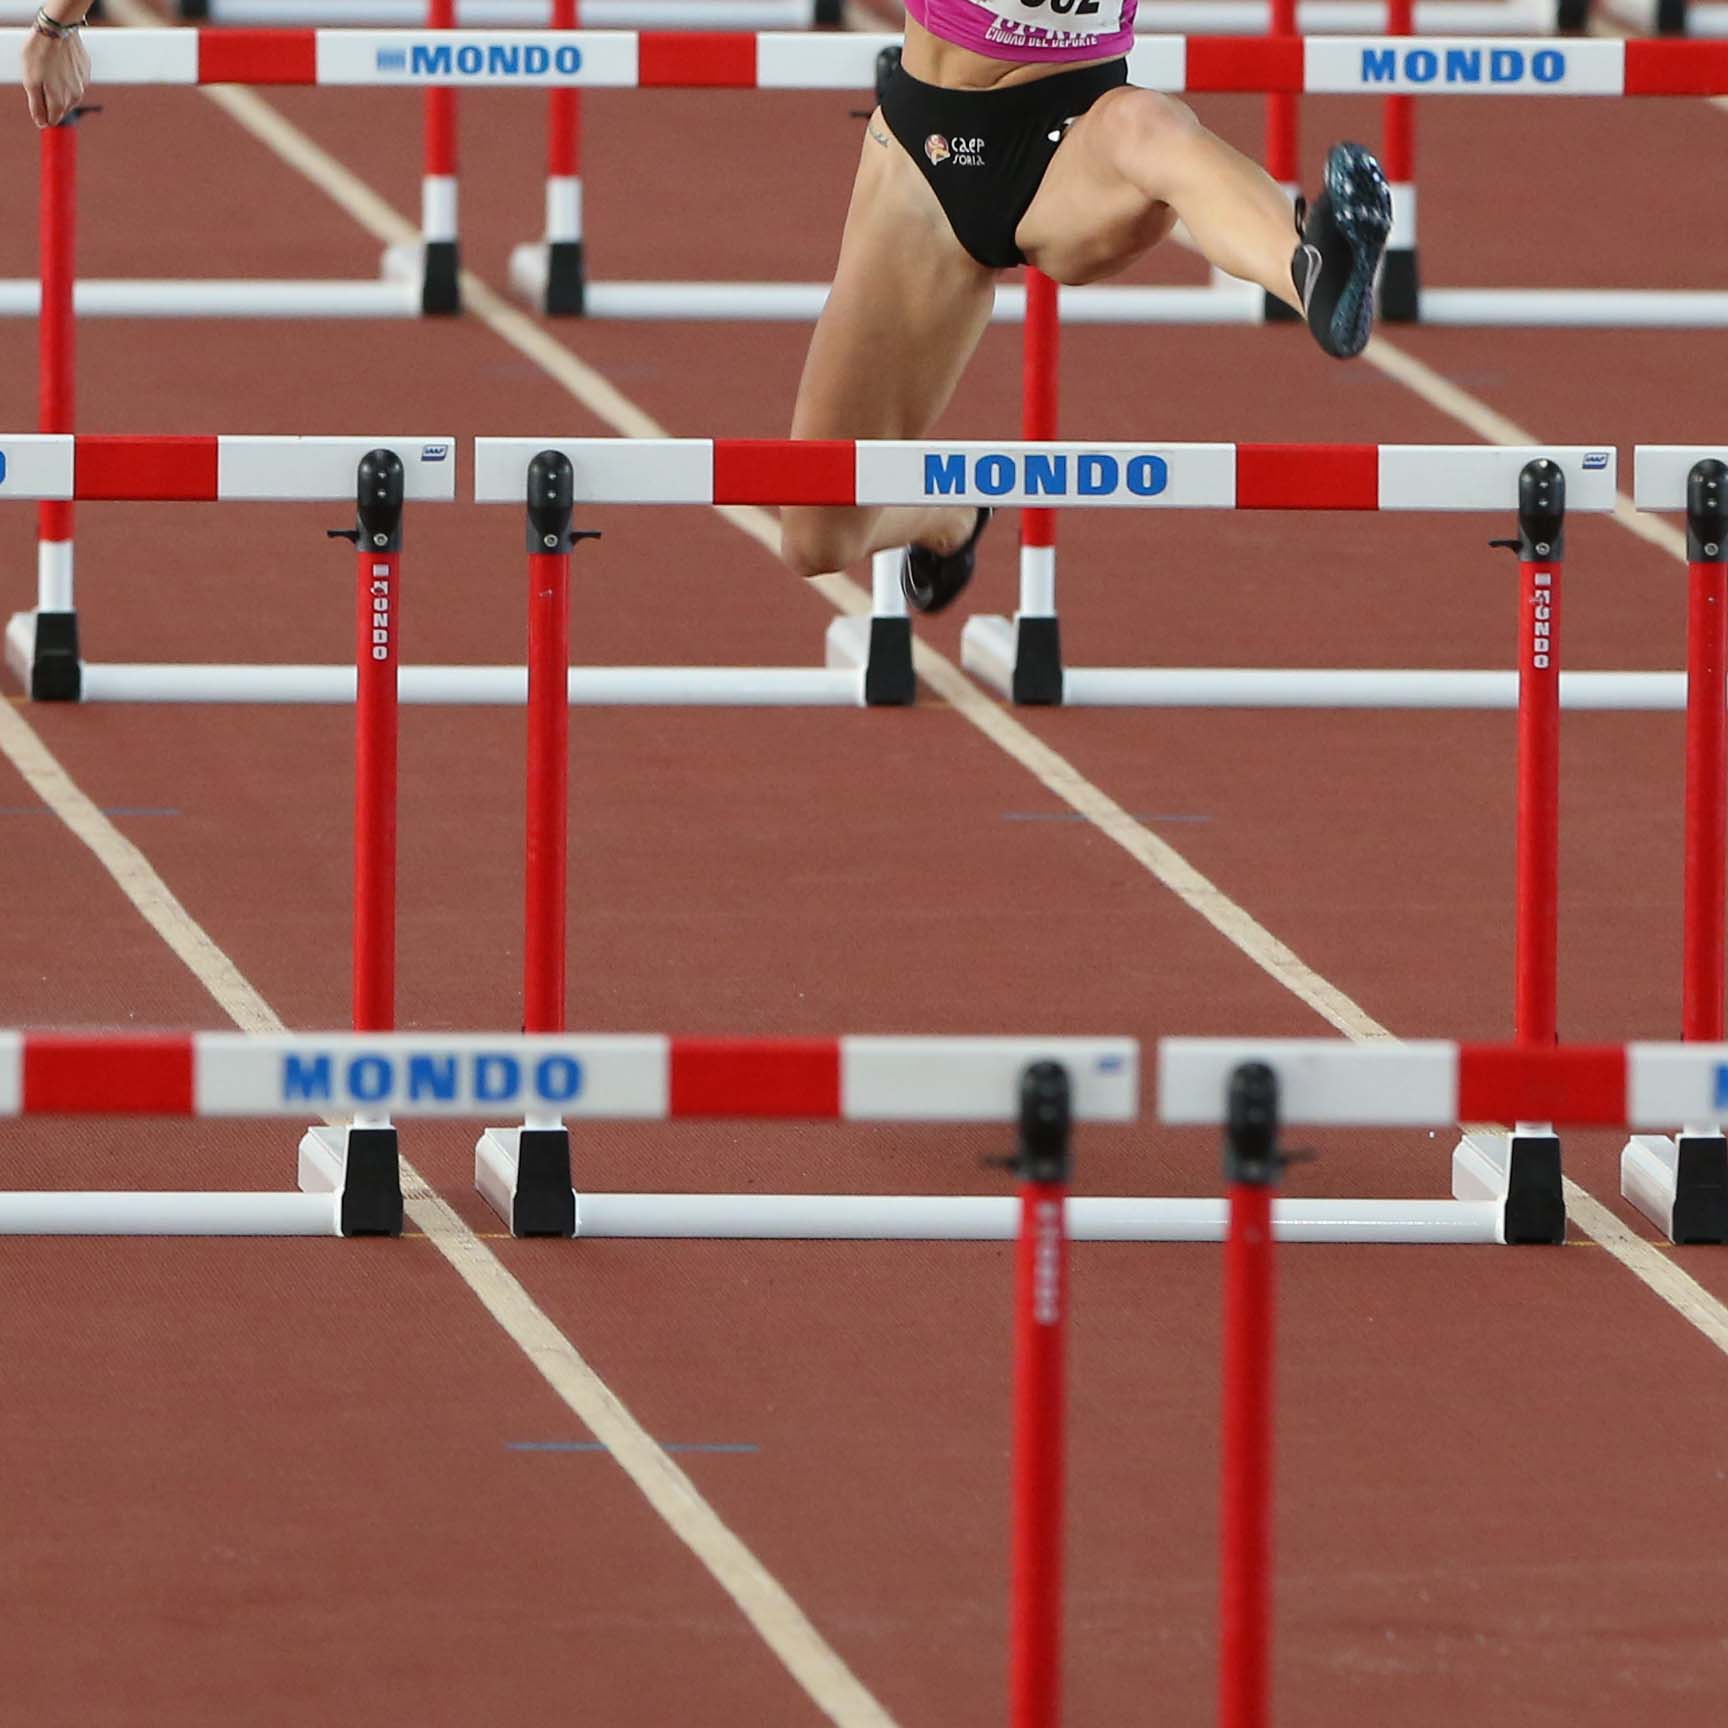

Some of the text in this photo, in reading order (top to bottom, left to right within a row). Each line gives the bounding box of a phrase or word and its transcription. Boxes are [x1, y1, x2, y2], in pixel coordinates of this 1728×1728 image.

[985, 27, 1026, 46] CIUDAD
[1028, 36, 1049, 48] DEL
[1051, 36, 1099, 49] DEPORTE
[408, 44, 584, 76] MONDO
[1362, 48, 1567, 83] MONDO
[924, 454, 1169, 496] MONDO
[282, 1052, 585, 1104] MONDO
